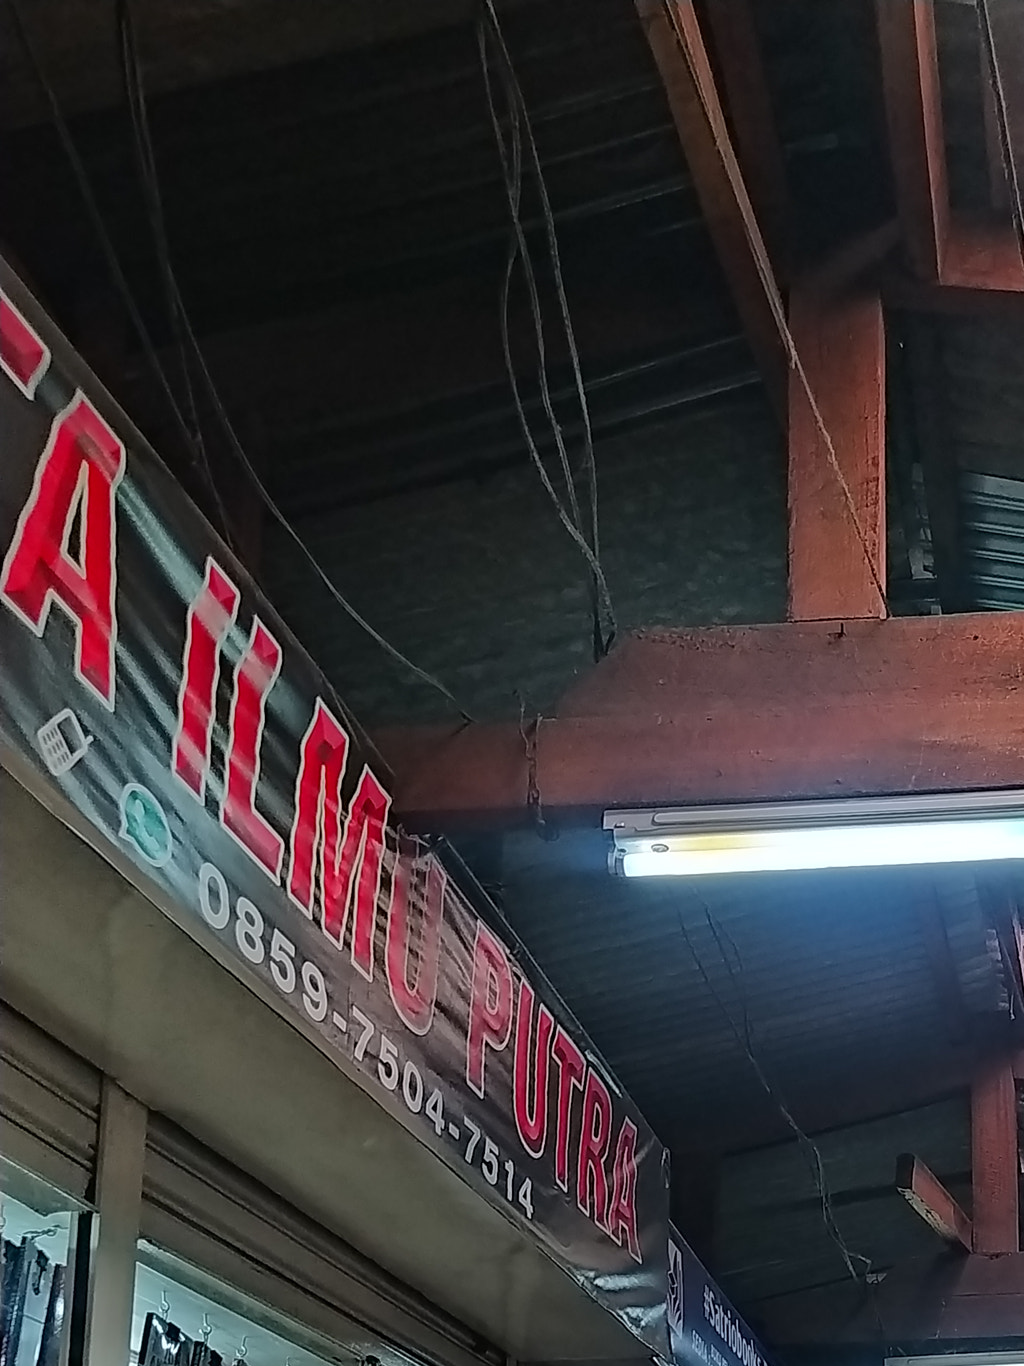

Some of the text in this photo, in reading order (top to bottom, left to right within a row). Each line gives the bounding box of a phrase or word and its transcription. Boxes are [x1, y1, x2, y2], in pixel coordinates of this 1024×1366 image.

[172, 555, 446, 1036] ILMU
[466, 918, 643, 1265] PUTRA
[200, 862, 534, 1220] 0859-7504-7514
